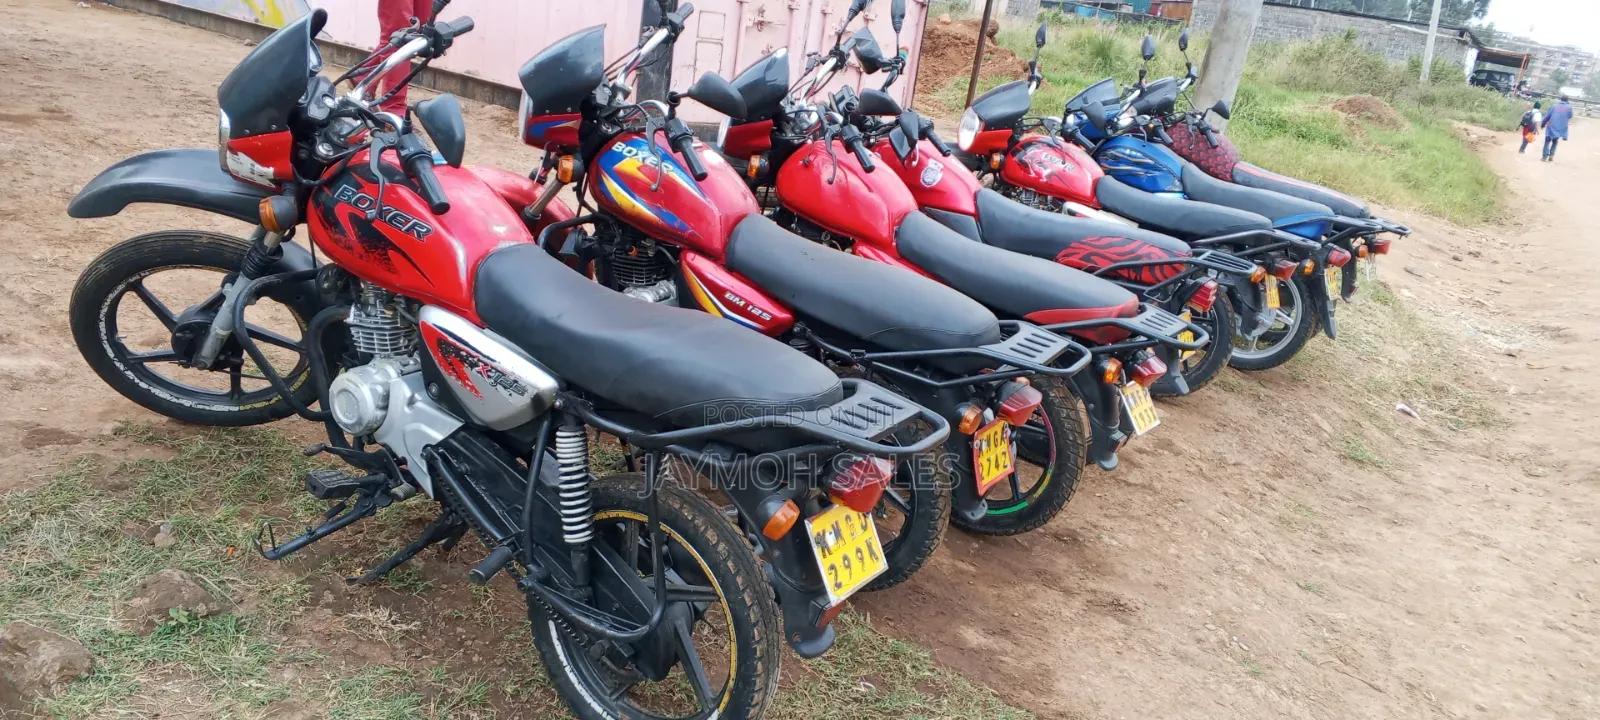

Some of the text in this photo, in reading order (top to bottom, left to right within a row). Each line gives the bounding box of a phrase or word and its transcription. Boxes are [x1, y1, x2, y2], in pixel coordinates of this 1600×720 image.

[611, 141, 675, 174] BOXER
[334, 184, 433, 242] BOXER
[724, 291, 772, 321] BM 125
[828, 537, 879, 591] 299K
